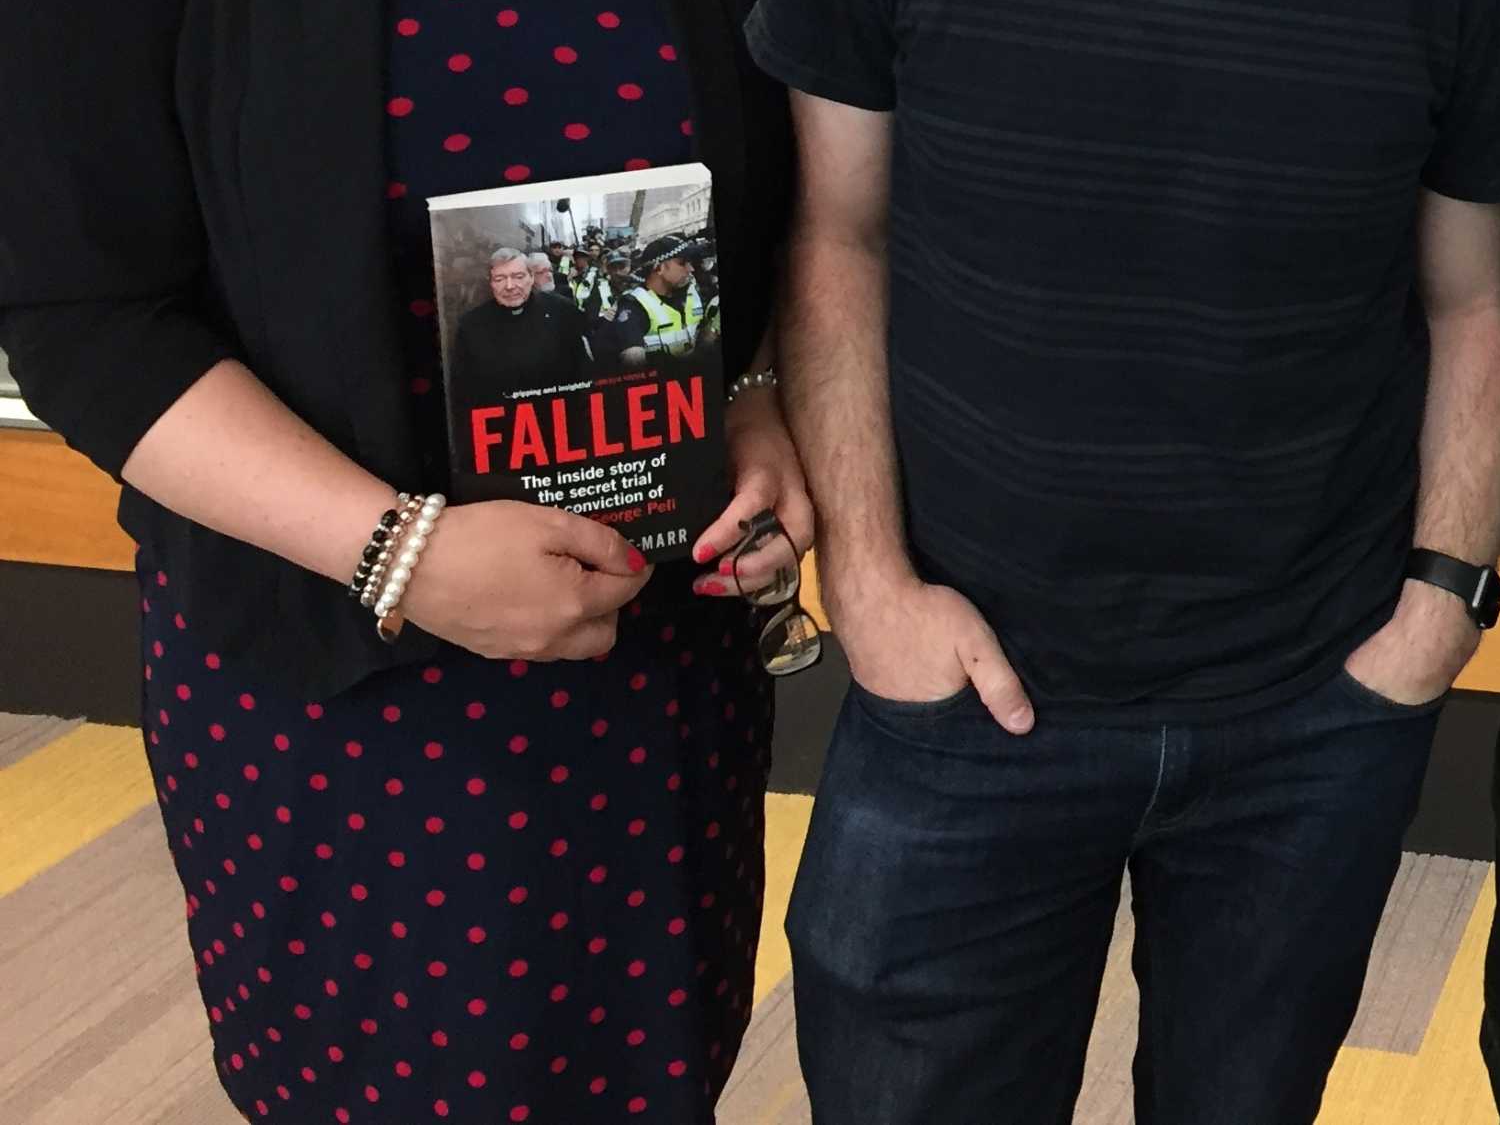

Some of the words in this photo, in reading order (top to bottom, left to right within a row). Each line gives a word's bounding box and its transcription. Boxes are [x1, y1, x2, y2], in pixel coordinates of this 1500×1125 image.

[543, 385, 557, 395] and
[471, 375, 706, 475] FALLEN
[521, 474, 552, 491] The
[557, 466, 605, 485] inside
[609, 459, 647, 478] story
[651, 453, 668, 469] of
[538, 487, 565, 504] the
[569, 482, 618, 500] secret
[621, 471, 653, 489] trial
[564, 488, 644, 515] conviction
[648, 485, 665, 500] of
[647, 499, 677, 516] Pell
